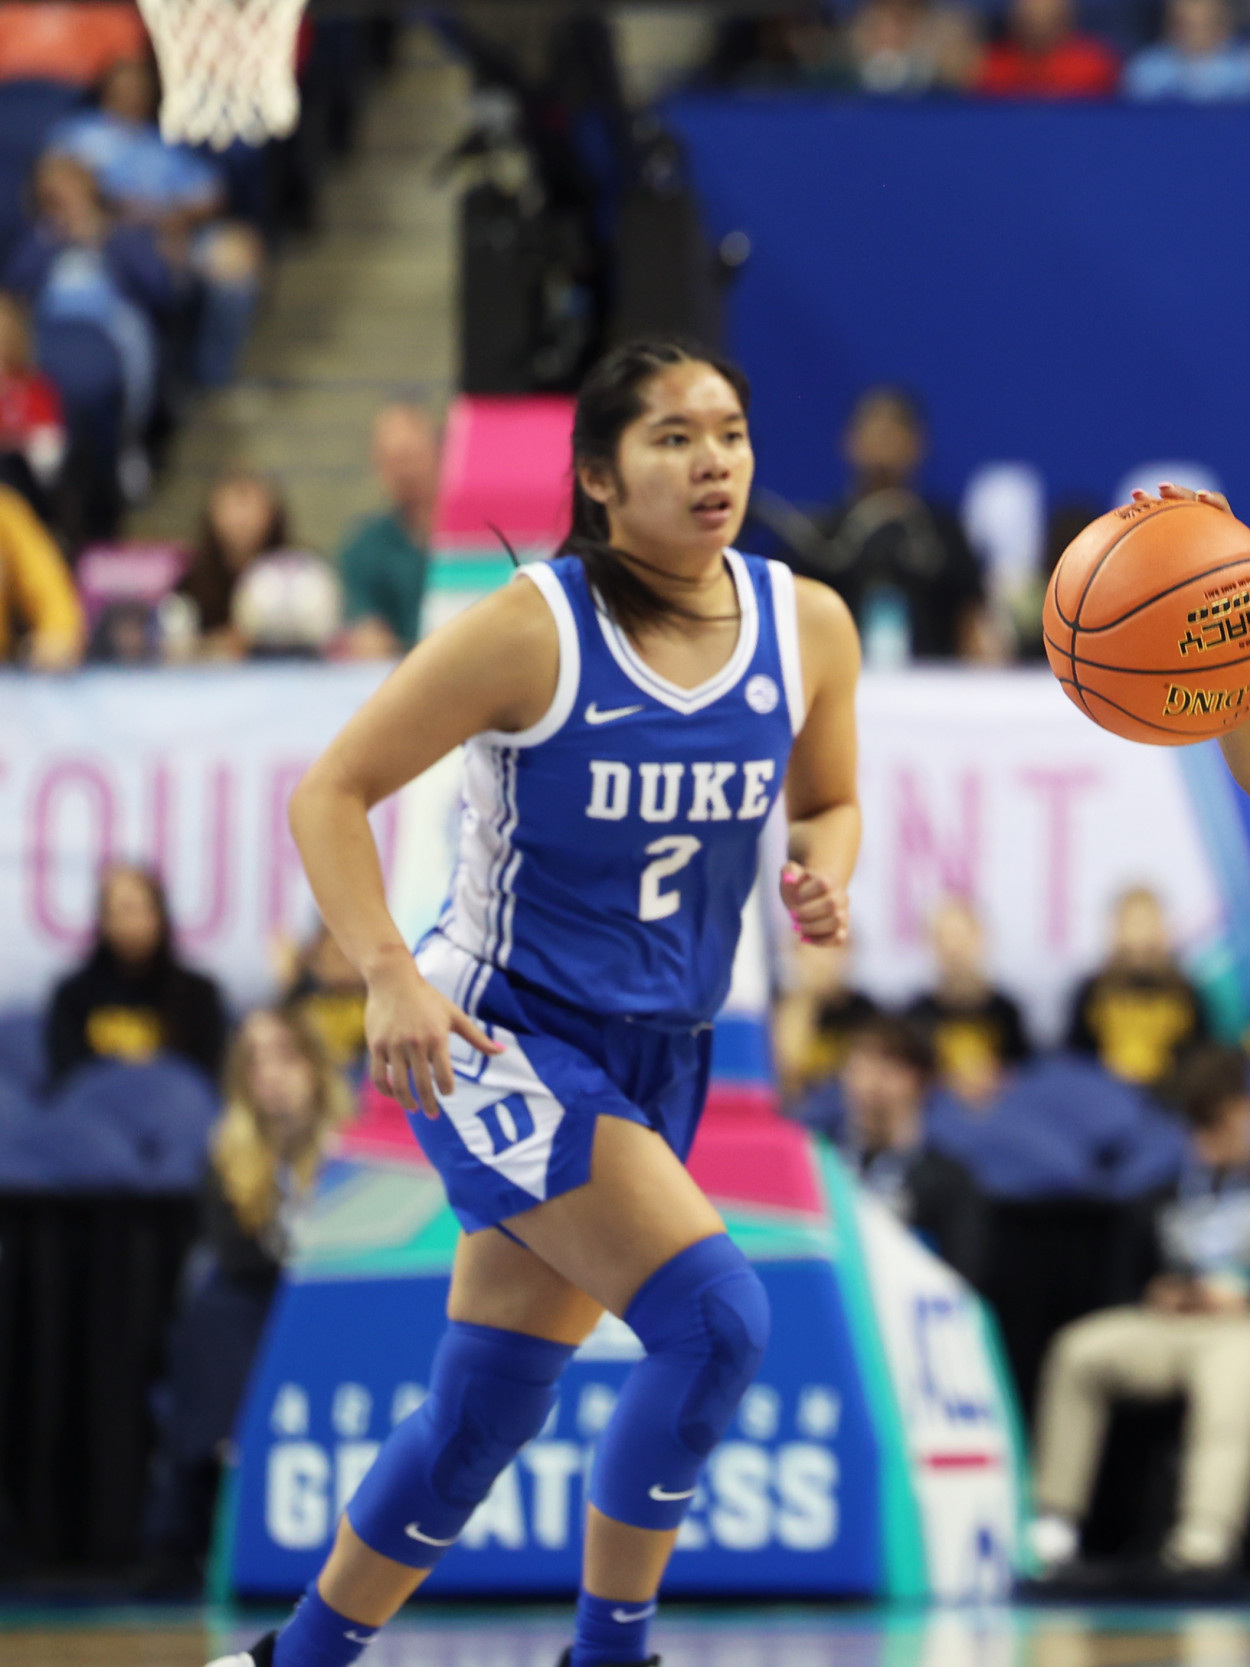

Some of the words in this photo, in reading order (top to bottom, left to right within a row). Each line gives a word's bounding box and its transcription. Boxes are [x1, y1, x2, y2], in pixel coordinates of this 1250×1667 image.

[586, 759, 775, 822] DUKE
[638, 835, 702, 921] 2
[475, 1092, 537, 1156] D
